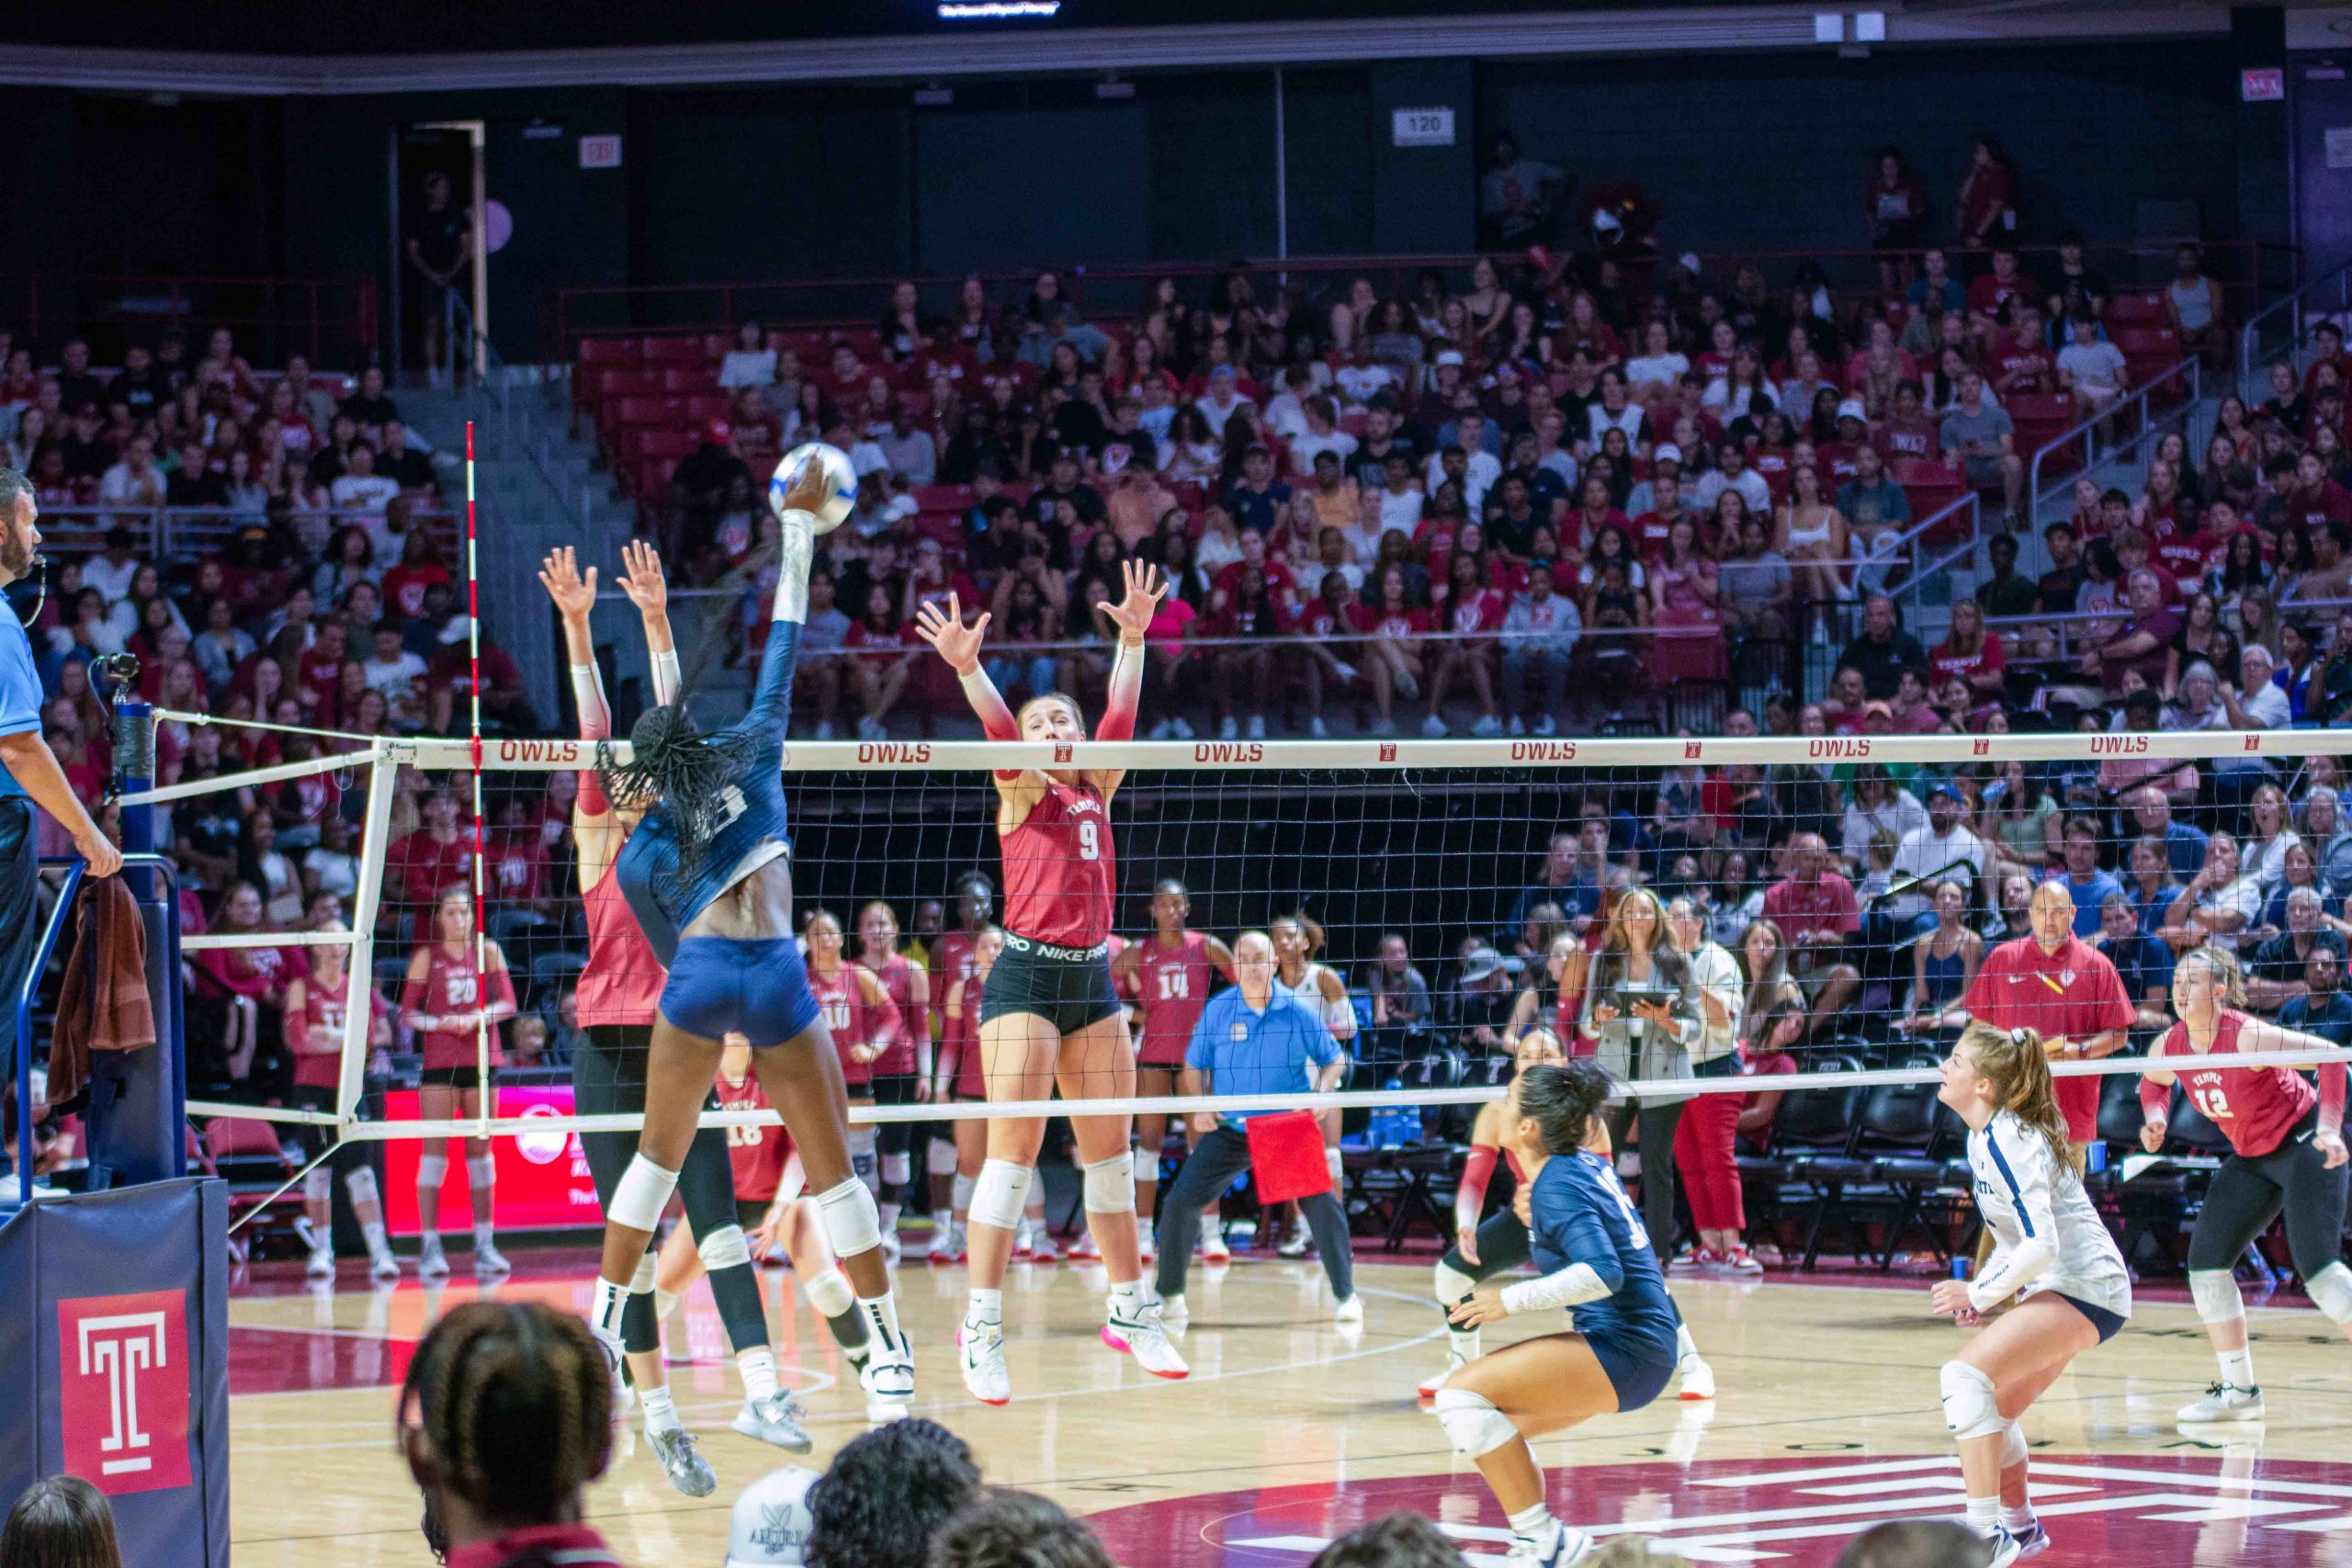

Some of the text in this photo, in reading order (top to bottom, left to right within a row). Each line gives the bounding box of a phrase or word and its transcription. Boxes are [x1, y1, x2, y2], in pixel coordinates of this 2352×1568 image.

[1410, 116, 1441, 132] 120
[501, 741, 578, 762] OWLS
[858, 743, 931, 763] OWLS
[1057, 744, 1071, 762] T
[1194, 743, 1263, 762] OWLS
[1381, 743, 1396, 761] T
[1511, 741, 1577, 761] OWLS
[1809, 739, 1871, 757] OWLS
[2090, 736, 2148, 753] OWLS
[1067, 799, 1102, 816] TEMPLE
[1080, 820, 1099, 860] 9
[1036, 945, 1086, 962] NIKE
[447, 976, 478, 1006] 20
[1158, 973, 1189, 1000] 14
[2192, 1071, 2222, 1087] TEMPLE
[2194, 1089, 2234, 1118] 12
[726, 1124, 763, 1147] 18
[78, 1311, 167, 1475] T
